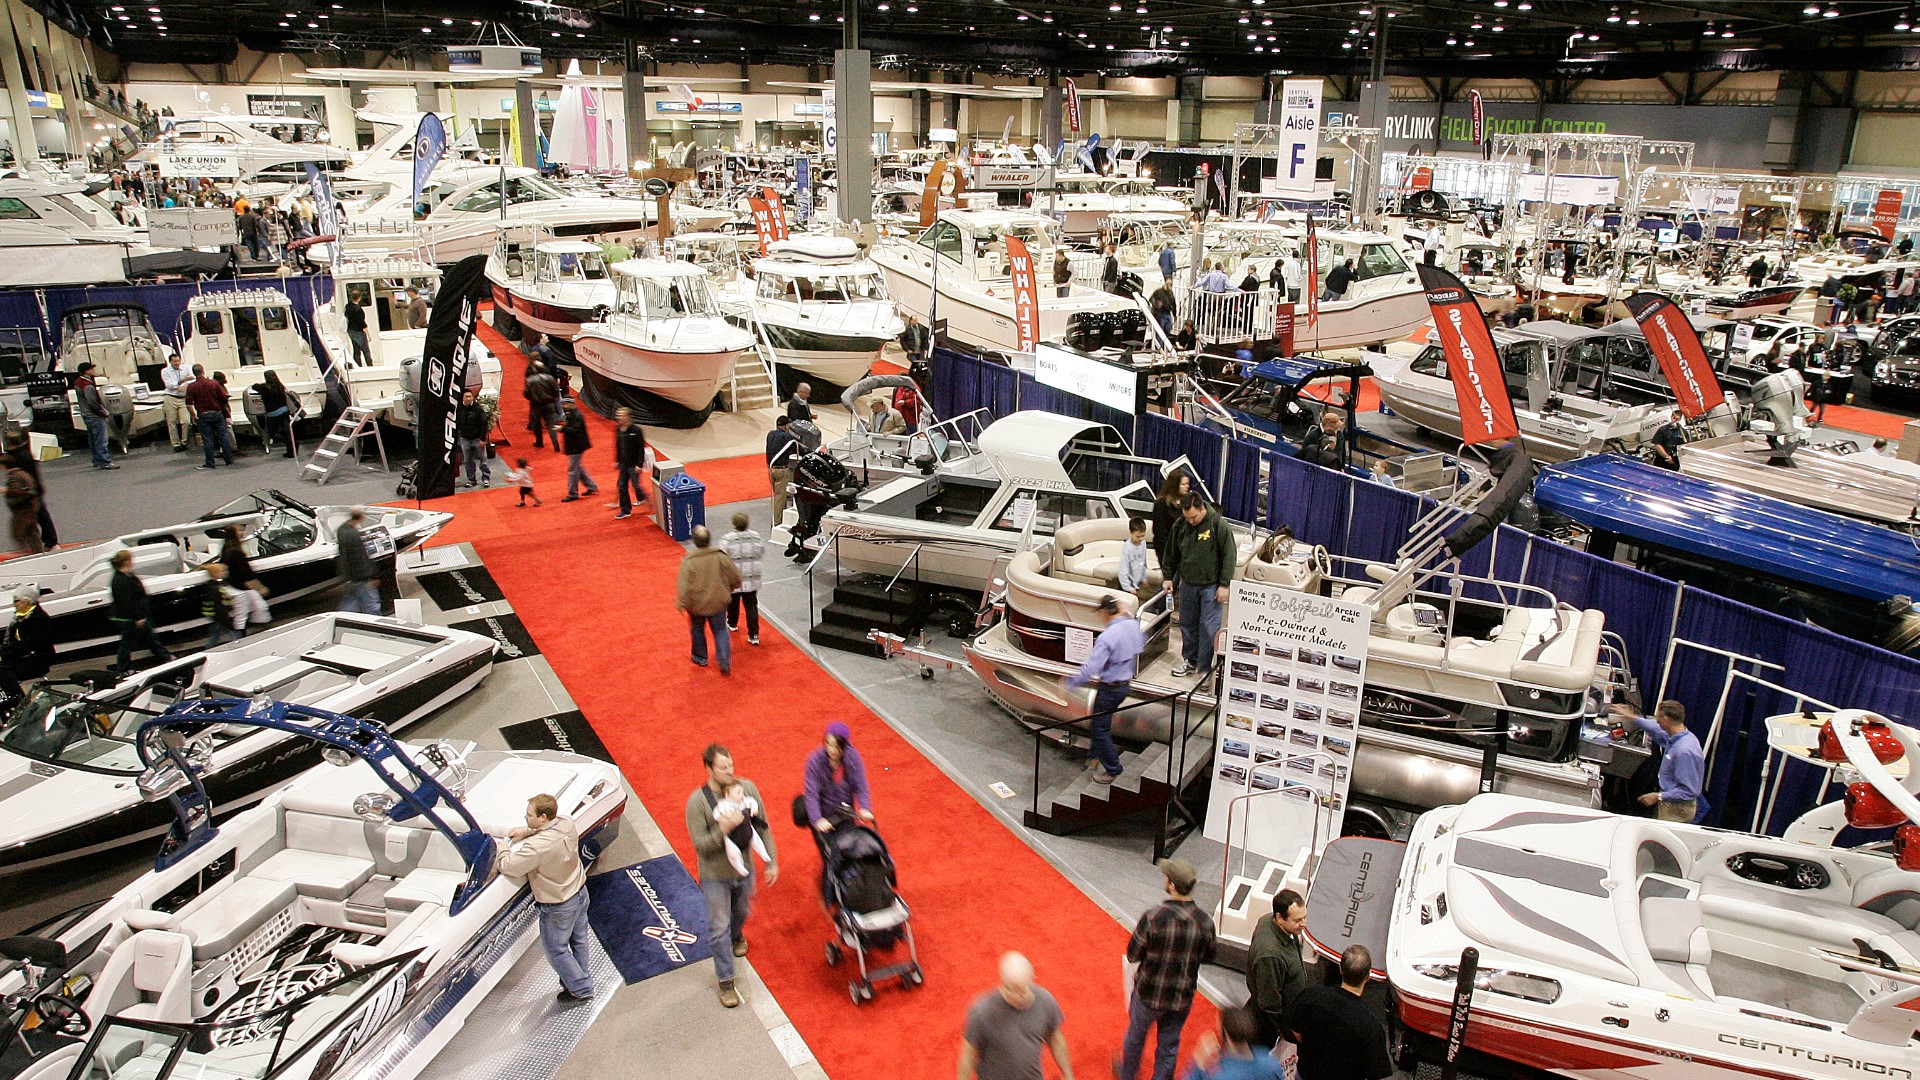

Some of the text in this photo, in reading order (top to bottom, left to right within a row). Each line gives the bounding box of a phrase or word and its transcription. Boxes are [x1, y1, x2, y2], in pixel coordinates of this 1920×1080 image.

[1285, 115, 1315, 131] Aisle
[826, 126, 836, 148] G
[1289, 143, 1306, 179] F
[991, 174, 1029, 182] WHALER
[1039, 359, 1058, 372] BOATS
[444, 295, 471, 464] NAUTIQUE
[1108, 382, 1132, 396] MOTORS
[799, 467, 828, 488] MERCURY
[1012, 476, 1071, 491] 2025 HHT
[1239, 588, 1259, 599] Boats
[1240, 596, 1266, 605] Motors
[1335, 606, 1361, 618] Arctic
[1341, 615, 1355, 624] Cat
[1257, 614, 1328, 637] Pre-Owned &
[1239, 621, 1348, 651] Non-Current Models
[1341, 851, 1373, 938] CENTURION
[662, 942, 683, 963] AIR
[1717, 1033, 1912, 1080] CENTURION
